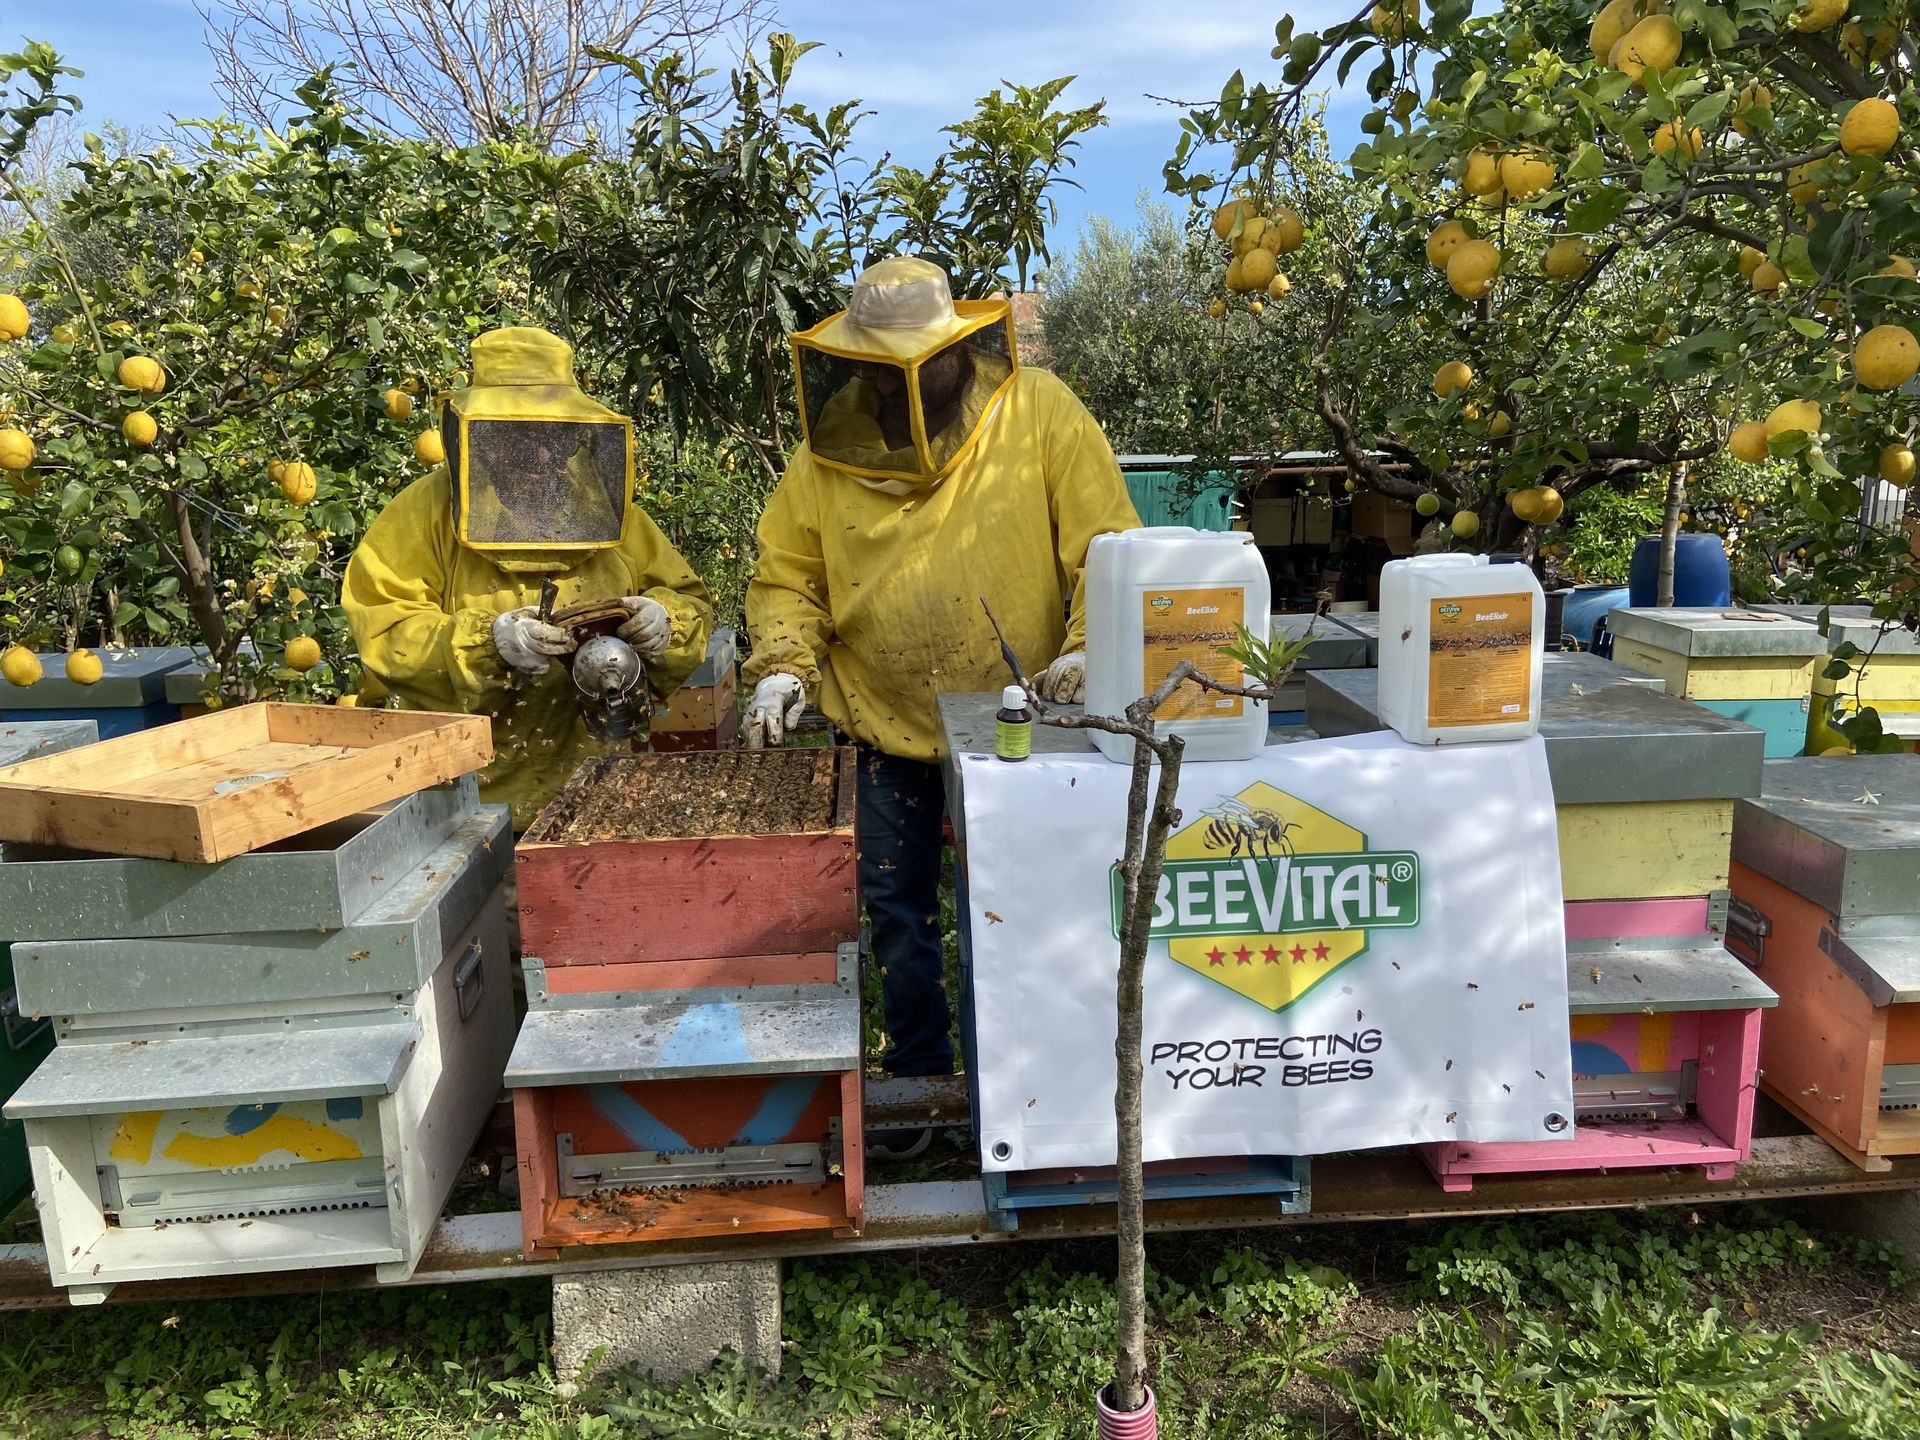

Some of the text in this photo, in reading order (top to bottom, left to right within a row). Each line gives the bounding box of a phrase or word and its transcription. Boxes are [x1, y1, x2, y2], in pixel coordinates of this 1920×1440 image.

[1187, 606, 1219, 615] BeeElixir
[1475, 612, 1508, 621] BeeElixir
[1151, 1029, 1382, 1065] PROTECTING
[1166, 1059, 1373, 1089] YOUR BEES
